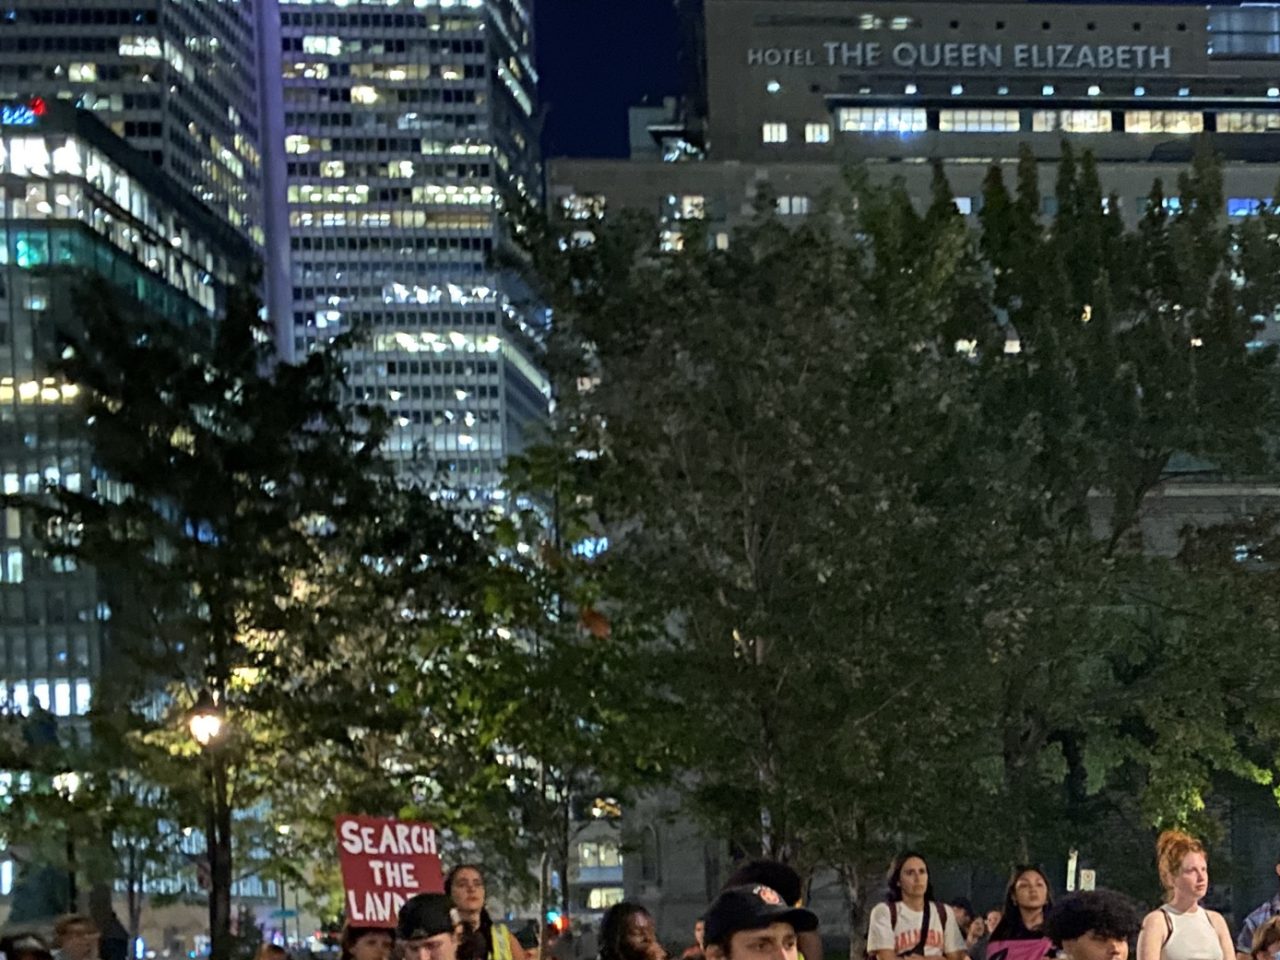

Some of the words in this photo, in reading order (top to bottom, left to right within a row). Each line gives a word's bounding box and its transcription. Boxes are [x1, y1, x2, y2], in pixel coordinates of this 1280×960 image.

[747, 48, 816, 66] HOTEL
[823, 41, 880, 67] THE
[892, 42, 1002, 68] QUEEN
[1014, 44, 1171, 69] ELIZABETH
[341, 820, 437, 855] SEARCH
[368, 860, 419, 888] THE
[347, 889, 417, 922] LAND
